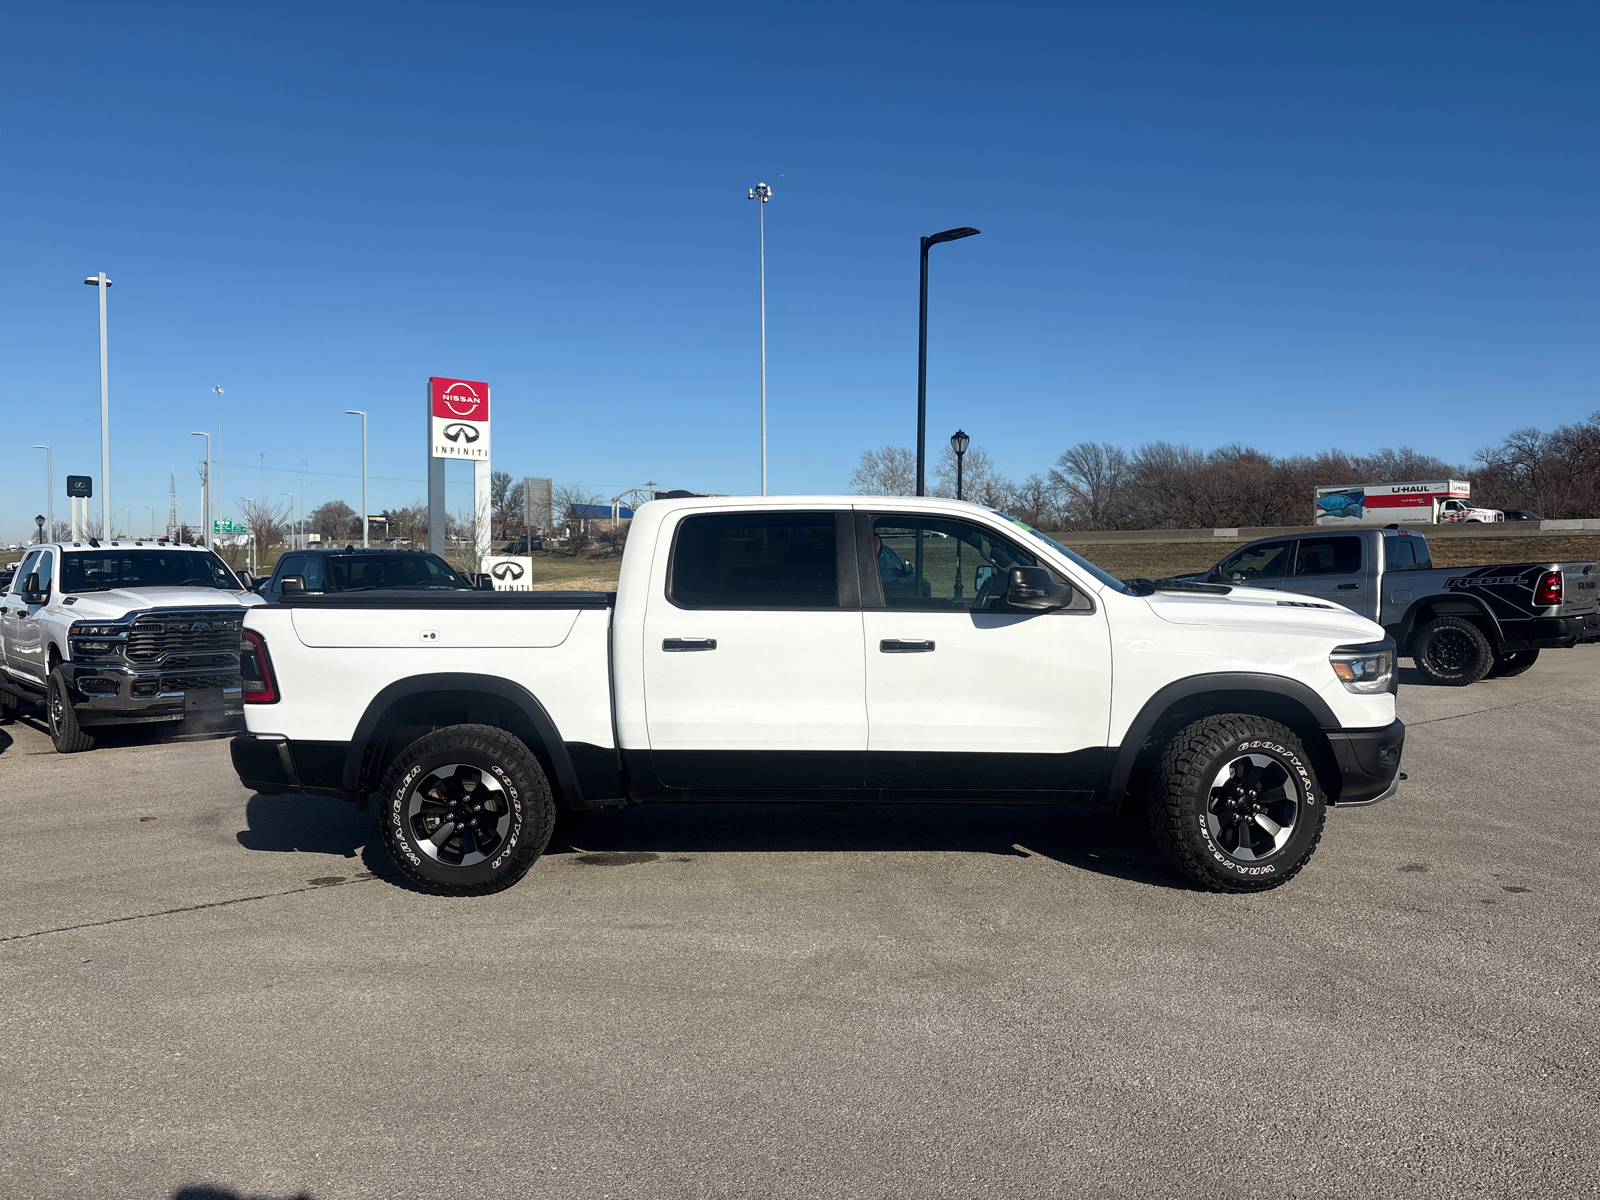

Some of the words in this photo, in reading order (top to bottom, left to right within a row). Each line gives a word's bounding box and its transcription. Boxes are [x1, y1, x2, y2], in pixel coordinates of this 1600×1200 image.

[442, 394, 481, 404] NISSAN
[435, 446, 488, 457] INFINITI
[1443, 576, 1529, 589] REBEL
[167, 621, 234, 632] RAM
[1237, 740, 1315, 806] GOODYEAR
[392, 765, 422, 867] WRANGLER
[491, 765, 523, 869] GOODYEAR
[1199, 814, 1276, 876] WRANGLER
